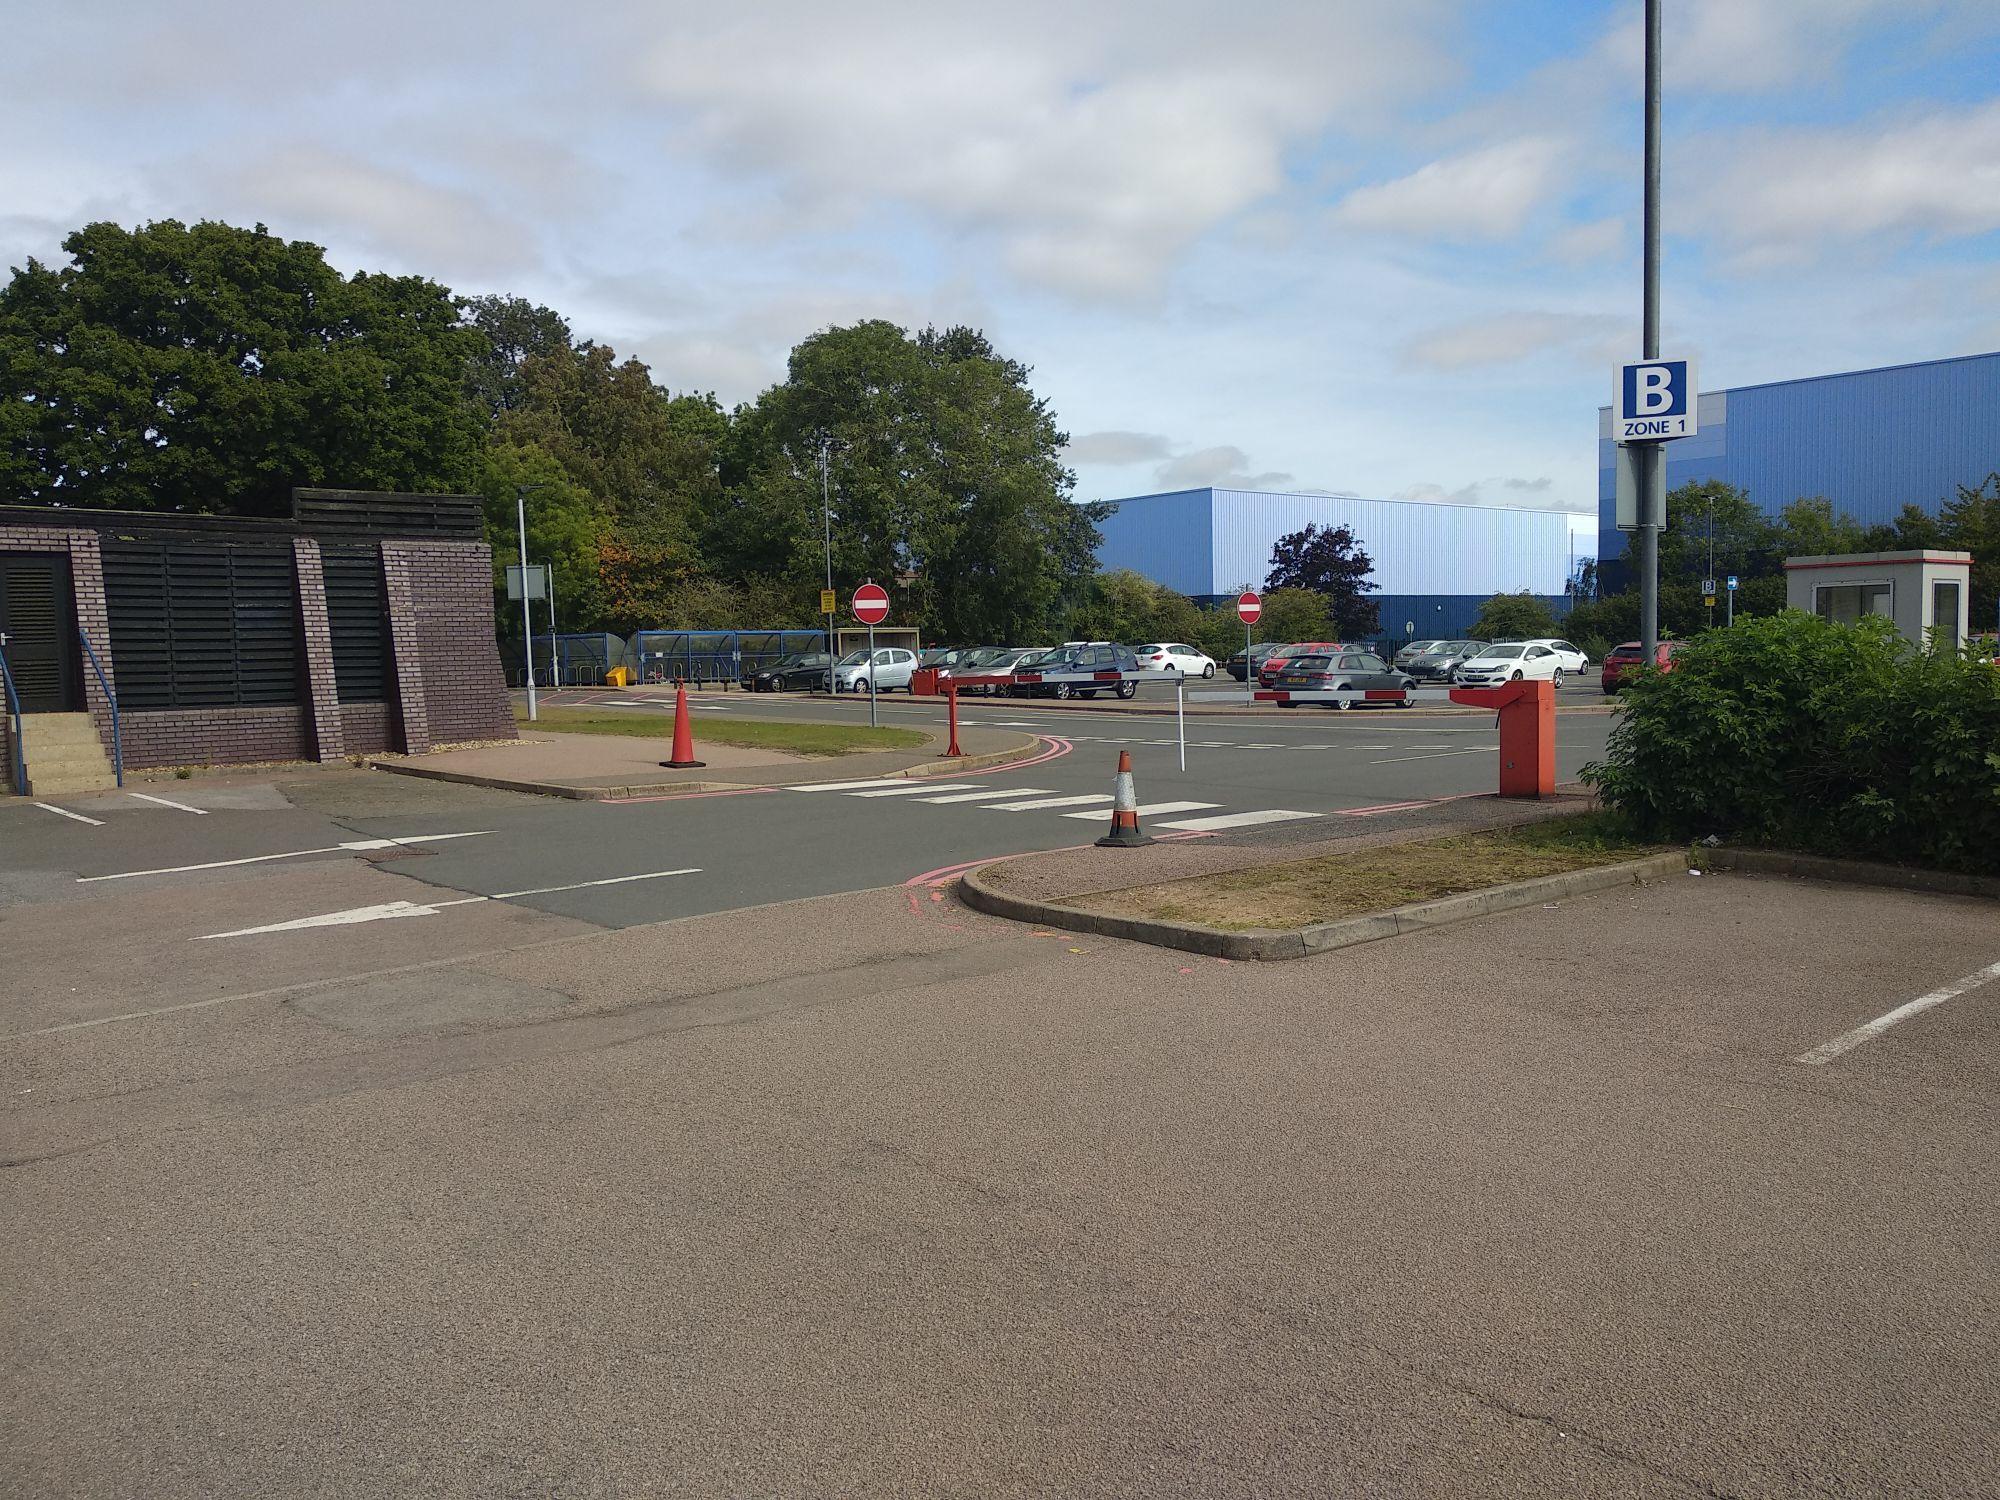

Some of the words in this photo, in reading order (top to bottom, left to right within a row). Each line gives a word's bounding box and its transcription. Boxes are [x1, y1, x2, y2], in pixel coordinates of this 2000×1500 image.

[1636, 366, 1673, 415] B
[1624, 420, 1670, 436] ZONE
[1678, 419, 1685, 432] 1
[1705, 581, 1712, 591] B
